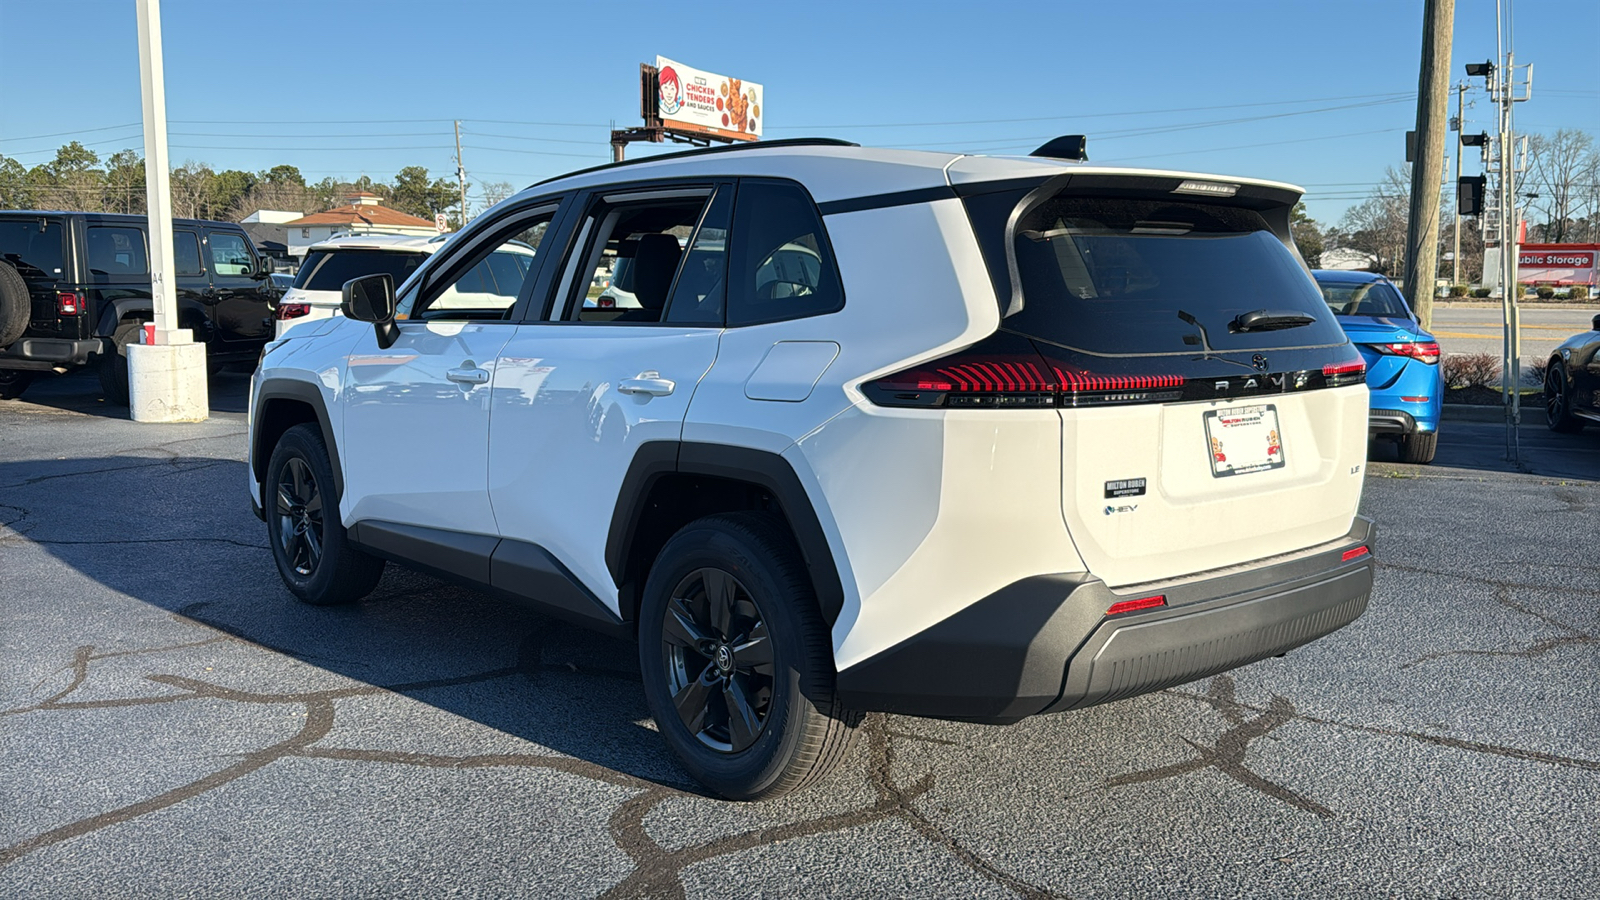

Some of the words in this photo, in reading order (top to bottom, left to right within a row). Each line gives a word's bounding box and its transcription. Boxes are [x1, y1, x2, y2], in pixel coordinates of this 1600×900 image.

[686, 83, 715, 96] CHICKEN
[686, 92, 715, 105] TENDERS
[686, 101, 696, 109] AND
[697, 103, 715, 112] SAUCES
[1518, 255, 1544, 264] ublic
[1546, 255, 1589, 267] Storage
[152, 272, 163, 284] A4
[1350, 465, 1360, 475] LE
[1106, 481, 1127, 490] MILTON
[1127, 479, 1145, 488] RUBEN
